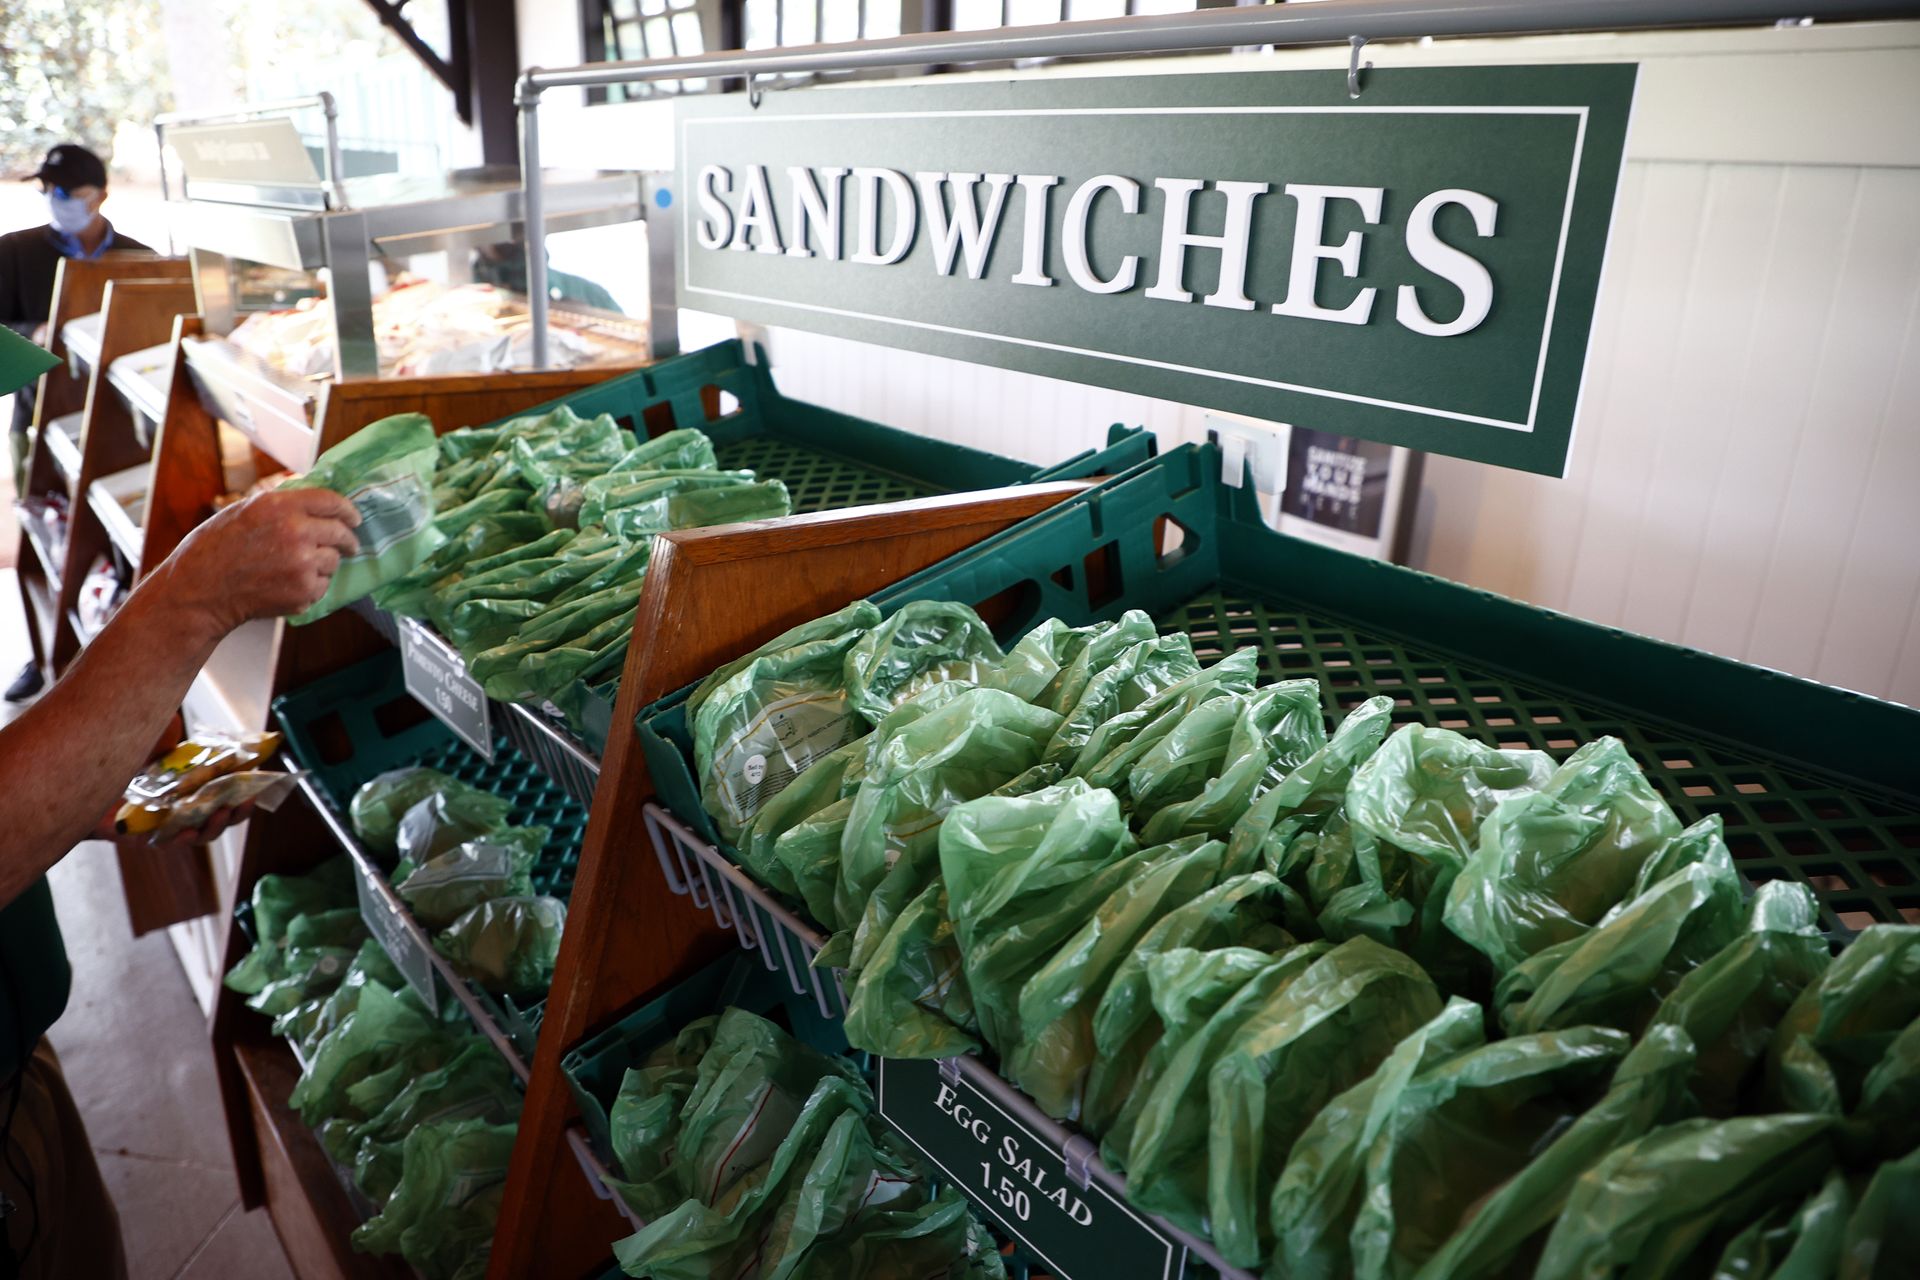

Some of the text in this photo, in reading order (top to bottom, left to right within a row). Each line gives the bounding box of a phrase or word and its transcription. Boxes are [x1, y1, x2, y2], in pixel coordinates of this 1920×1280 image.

[696, 165, 1499, 337] SANDWICHES
[933, 1082, 1093, 1226] EGG SALAD
[980, 1161, 1031, 1221] 1.50
